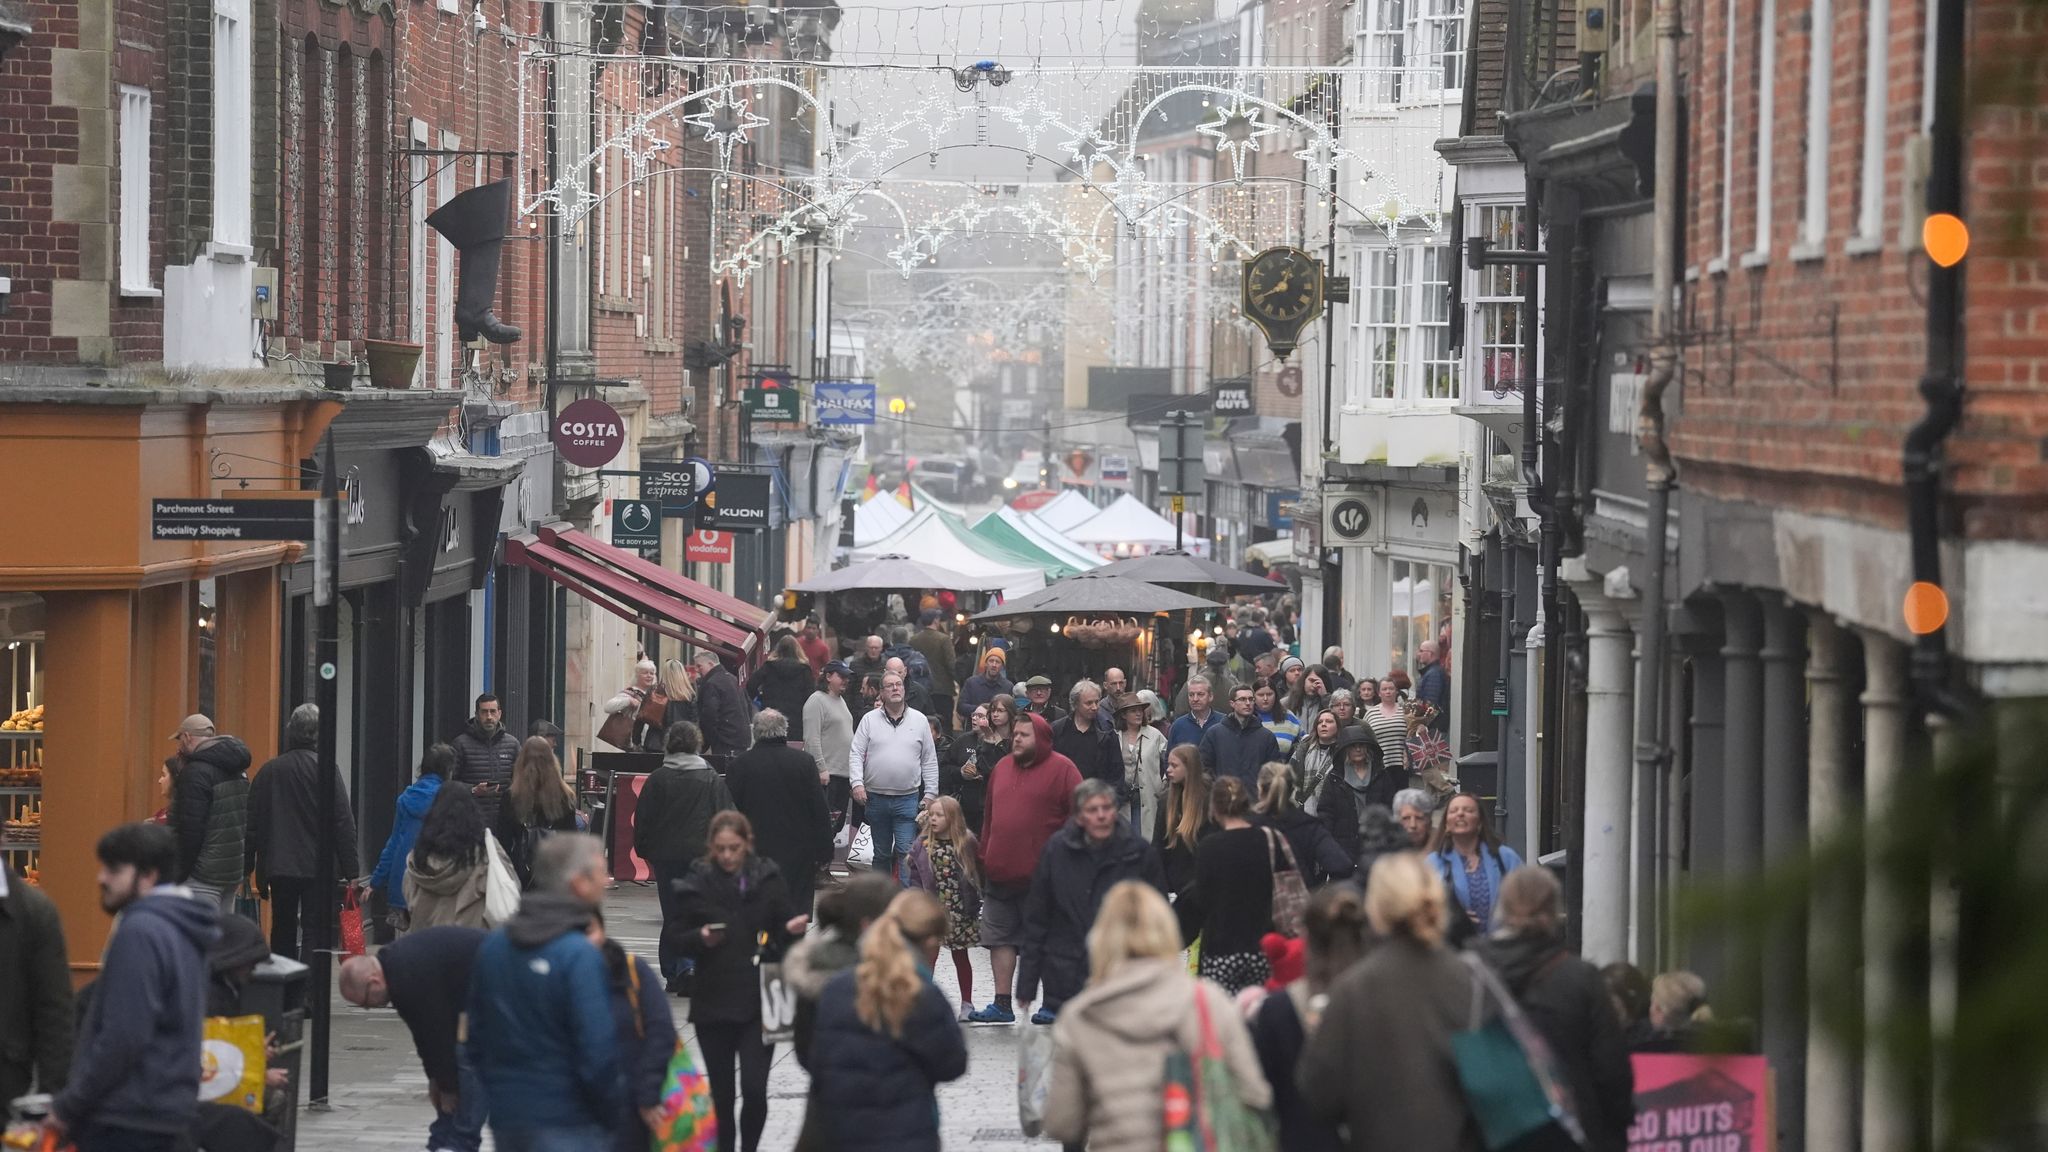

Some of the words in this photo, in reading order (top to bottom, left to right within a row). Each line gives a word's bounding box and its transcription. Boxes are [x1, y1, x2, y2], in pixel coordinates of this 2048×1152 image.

[1218, 389, 1247, 400] FIVE
[815, 399, 873, 409] HALIFAX
[1215, 399, 1250, 409] GUYS
[560, 422, 618, 438] COSTA
[573, 439, 605, 447] COFFEE
[646, 486, 689, 498] express
[156, 504, 204, 514] Parchment
[206, 504, 235, 514] Street
[719, 508, 764, 518] KUONI
[156, 525, 198, 537] Speciality
[200, 525, 241, 537] Shopping
[688, 544, 729, 554] vodafone
[1666, 1101, 1733, 1138] NUTS
